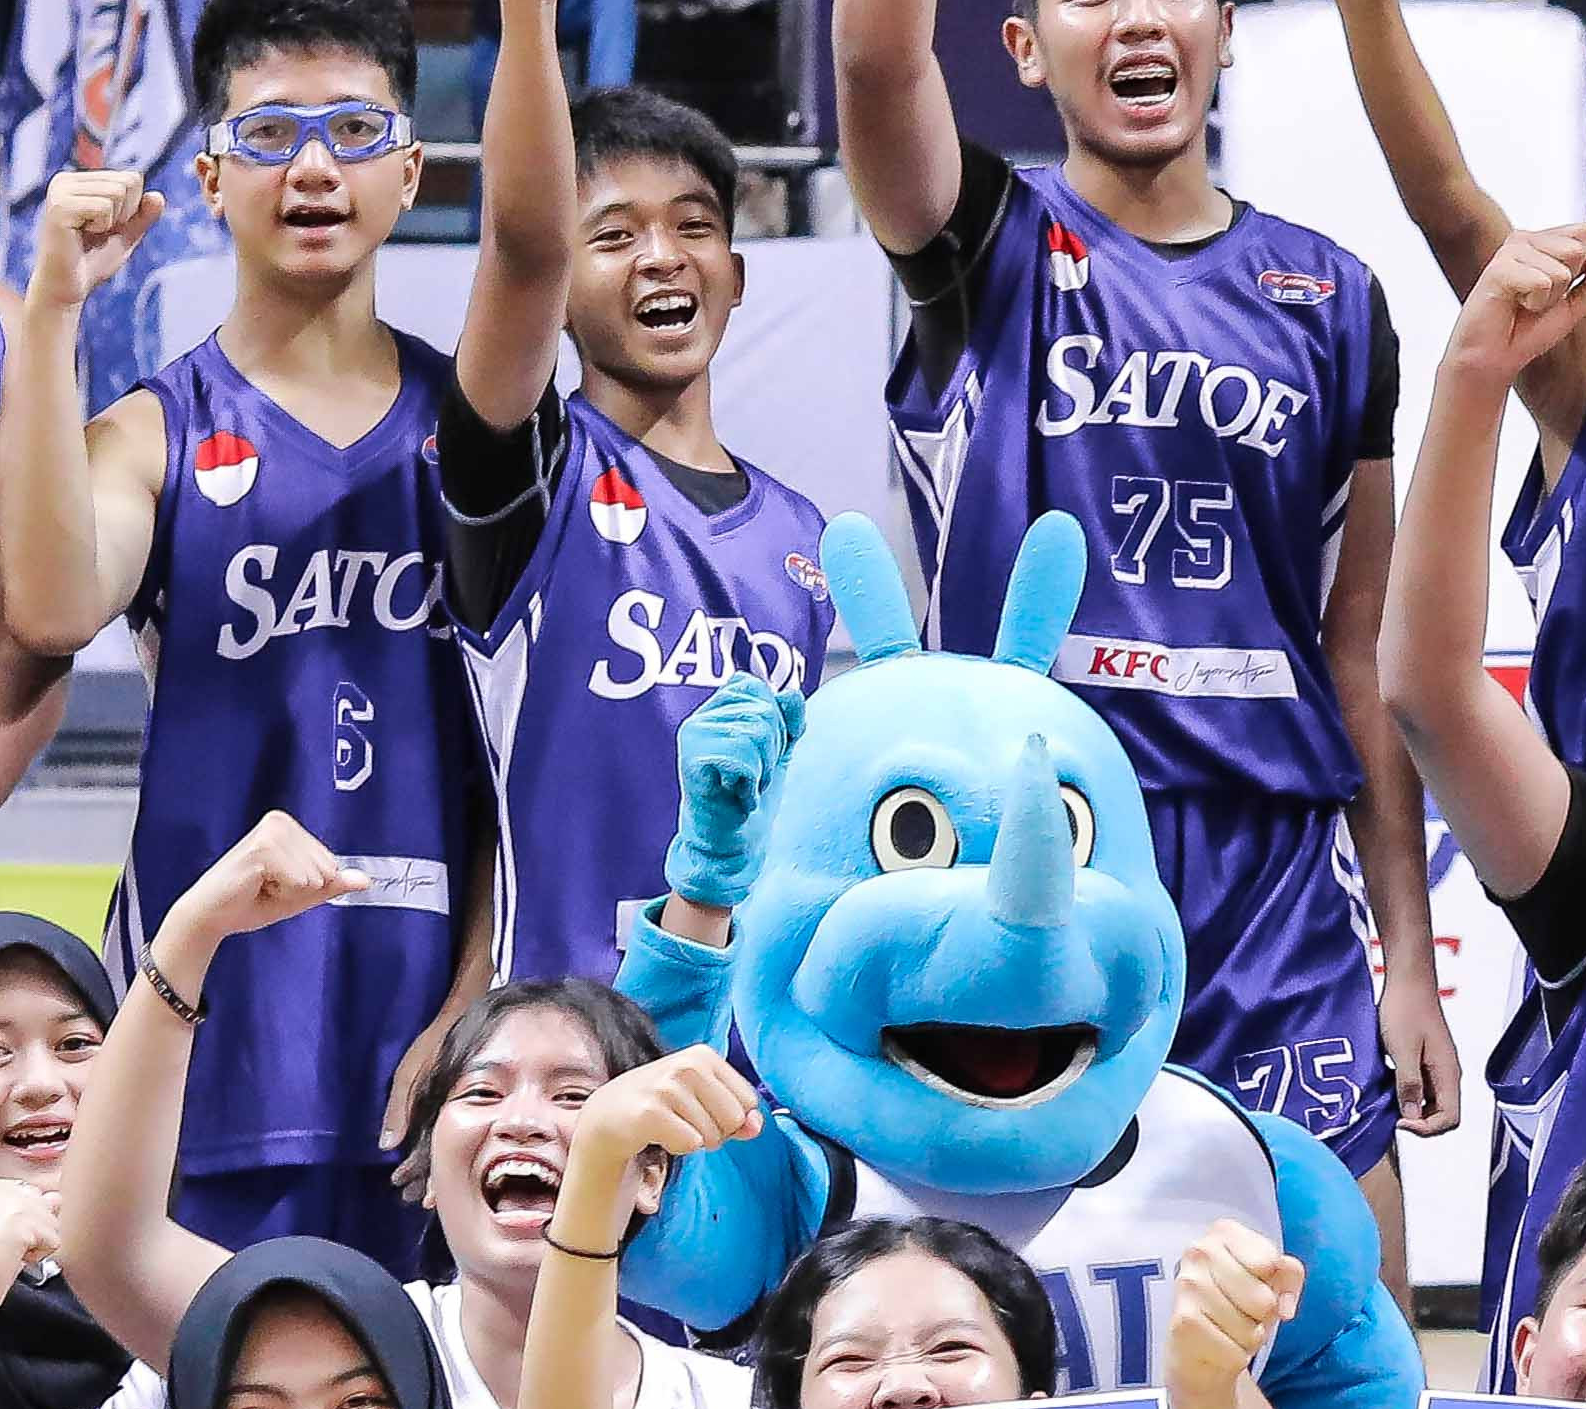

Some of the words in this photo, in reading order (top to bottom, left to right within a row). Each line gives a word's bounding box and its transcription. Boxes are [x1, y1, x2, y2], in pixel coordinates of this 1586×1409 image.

[1034, 334, 1310, 458] SATOE
[1110, 475, 1235, 590] 75
[1087, 645, 1170, 683] KFC
[332, 681, 375, 791] 6
[1233, 1037, 1362, 1141] 75
